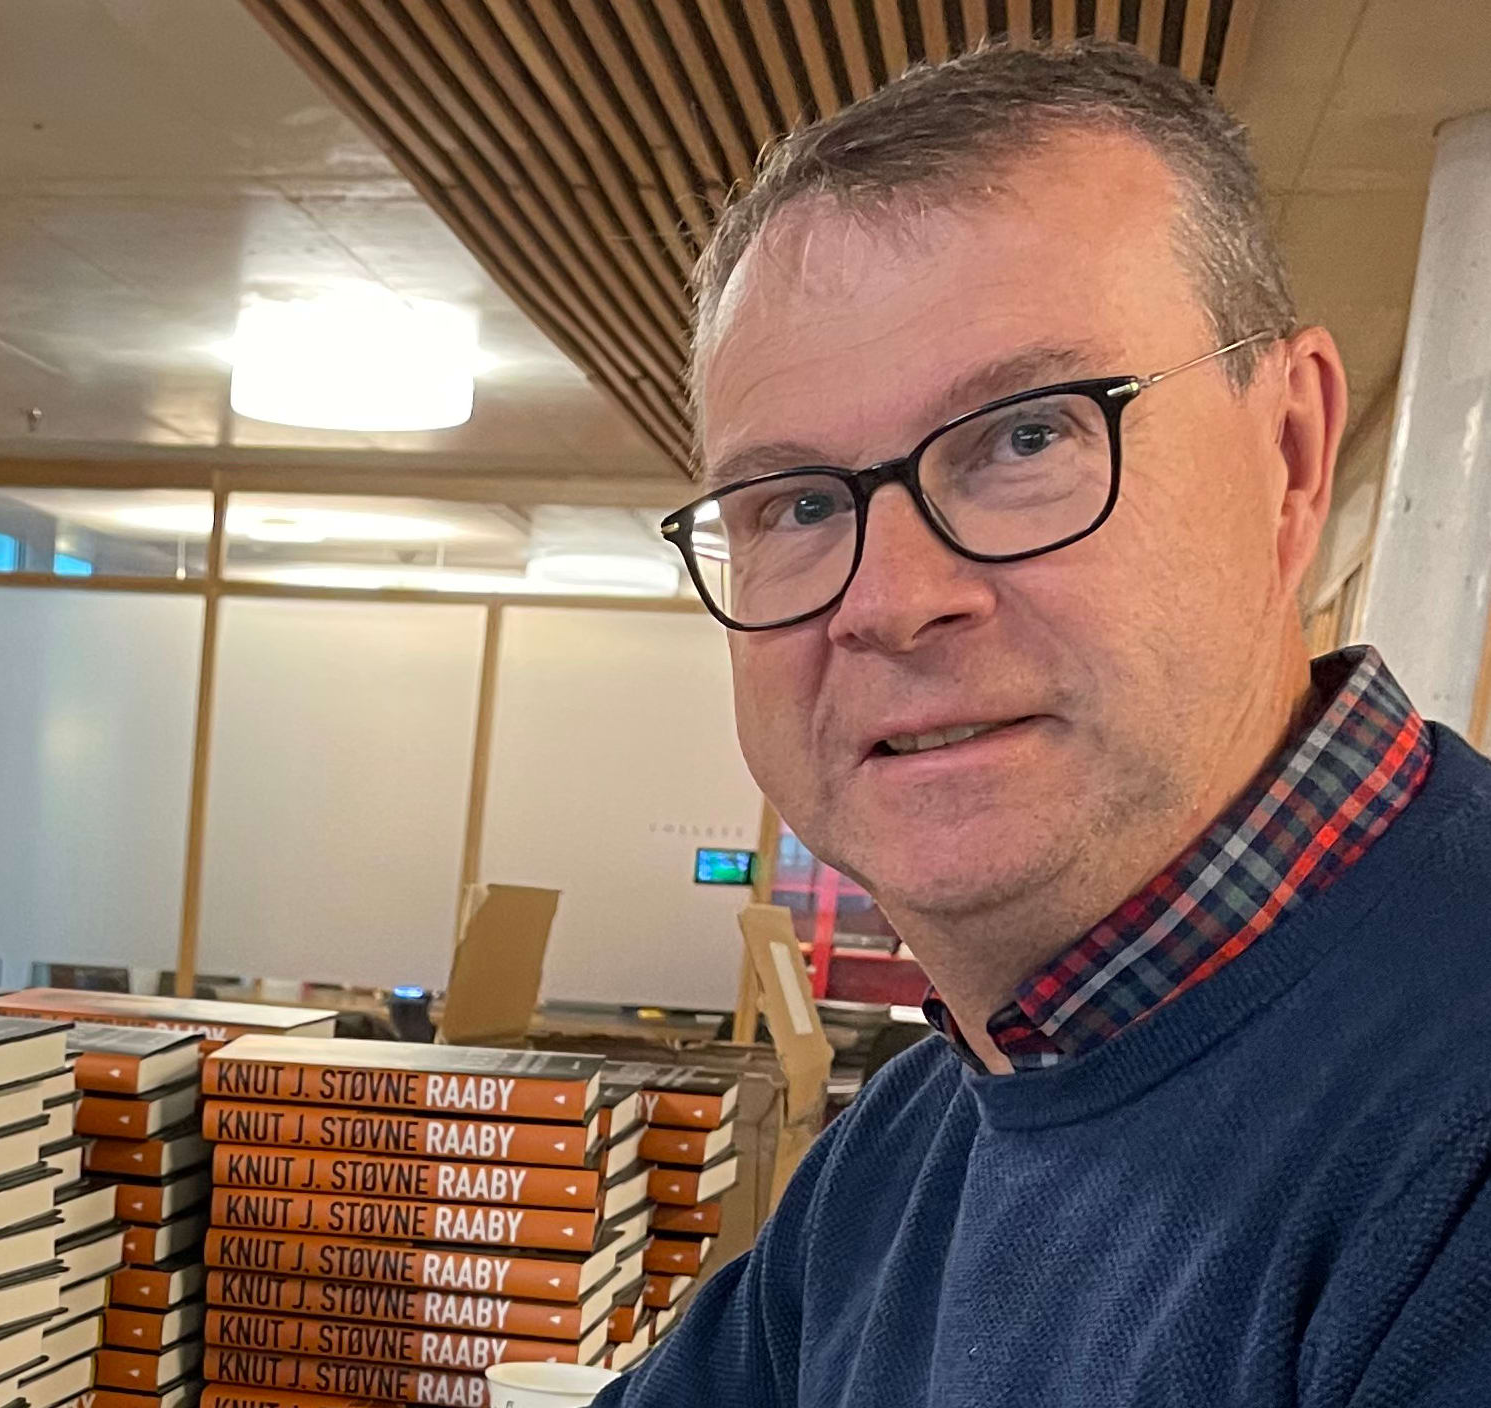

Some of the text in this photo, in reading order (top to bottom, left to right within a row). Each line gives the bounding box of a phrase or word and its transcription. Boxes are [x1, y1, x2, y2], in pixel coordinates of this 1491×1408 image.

[217, 1062, 515, 1111] KNUT J. STØVNE RAABY
[217, 1109, 515, 1158] KNUT J. STØVNE RAABY
[228, 1154, 526, 1201] KNUT J. STØVNE RAABY
[226, 1195, 524, 1243] KNUT J. STØVNE RAABY
[220, 1236, 511, 1291] KNUT J. STØVNE RAABY
[221, 1273, 511, 1330] KNUT J. STØVNE RAABY
[219, 1315, 508, 1368] KNUT J. STØVNE RAABY
[218, 1352, 282, 1385] KNUT
[288, 1359, 307, 1390] J.
[316, 1361, 410, 1399] STØVNE
